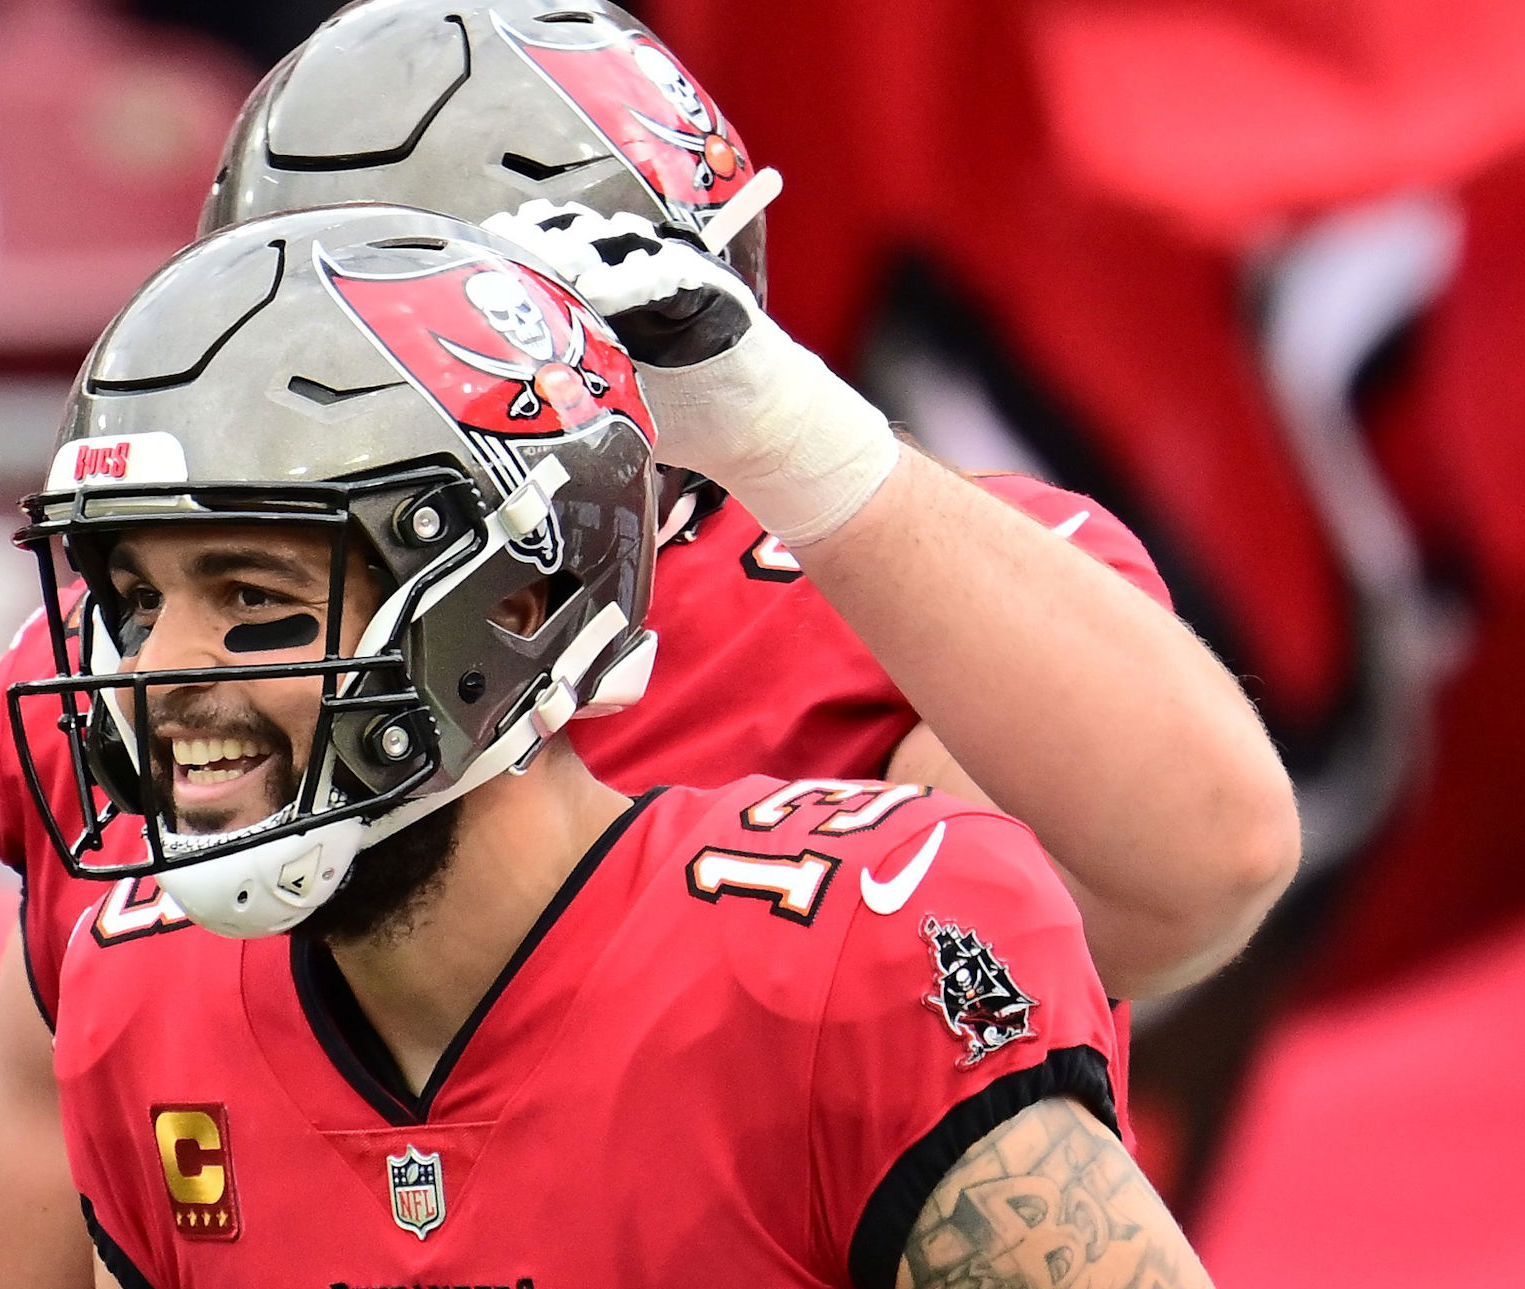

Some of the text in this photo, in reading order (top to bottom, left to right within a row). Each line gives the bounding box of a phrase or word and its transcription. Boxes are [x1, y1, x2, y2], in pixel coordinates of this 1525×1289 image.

[74, 442, 130, 481] BUCS
[686, 778, 934, 928] 13
[155, 1111, 225, 1205] C
[397, 1188, 436, 1223] NFL
